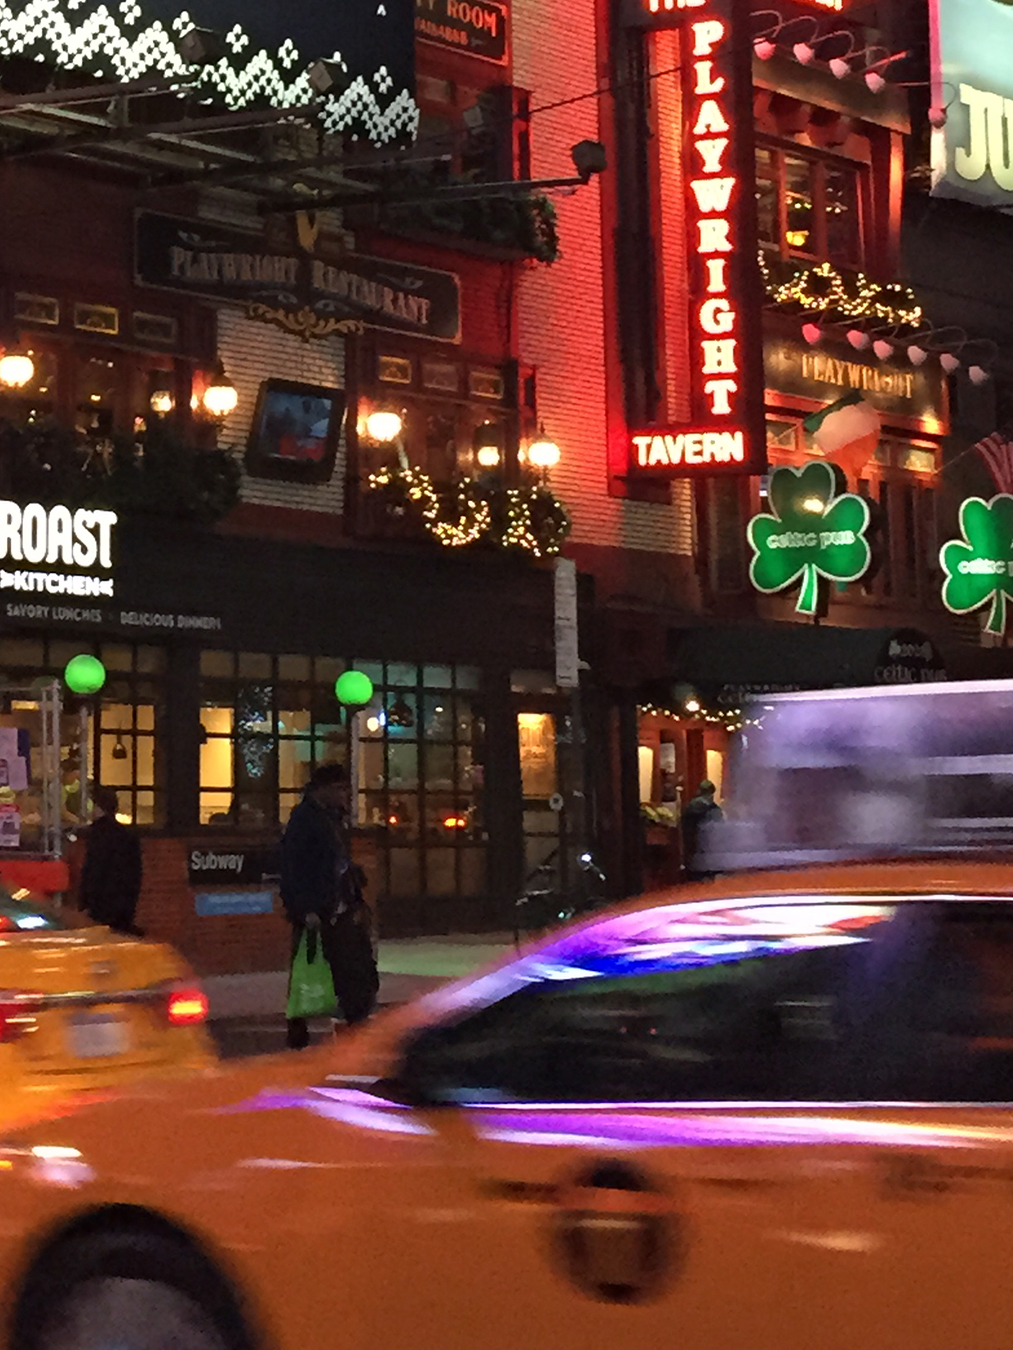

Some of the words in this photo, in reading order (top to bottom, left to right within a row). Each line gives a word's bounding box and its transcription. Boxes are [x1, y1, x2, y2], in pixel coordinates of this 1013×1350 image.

[690, 19, 738, 417] PLAYWRIGHT
[632, 430, 744, 467] TAVERN
[14, 570, 100, 597] KITCHEN
[6, 603, 50, 620] SAVORY
[120, 611, 175, 629] DELICIOUS
[191, 850, 245, 874] Subway
